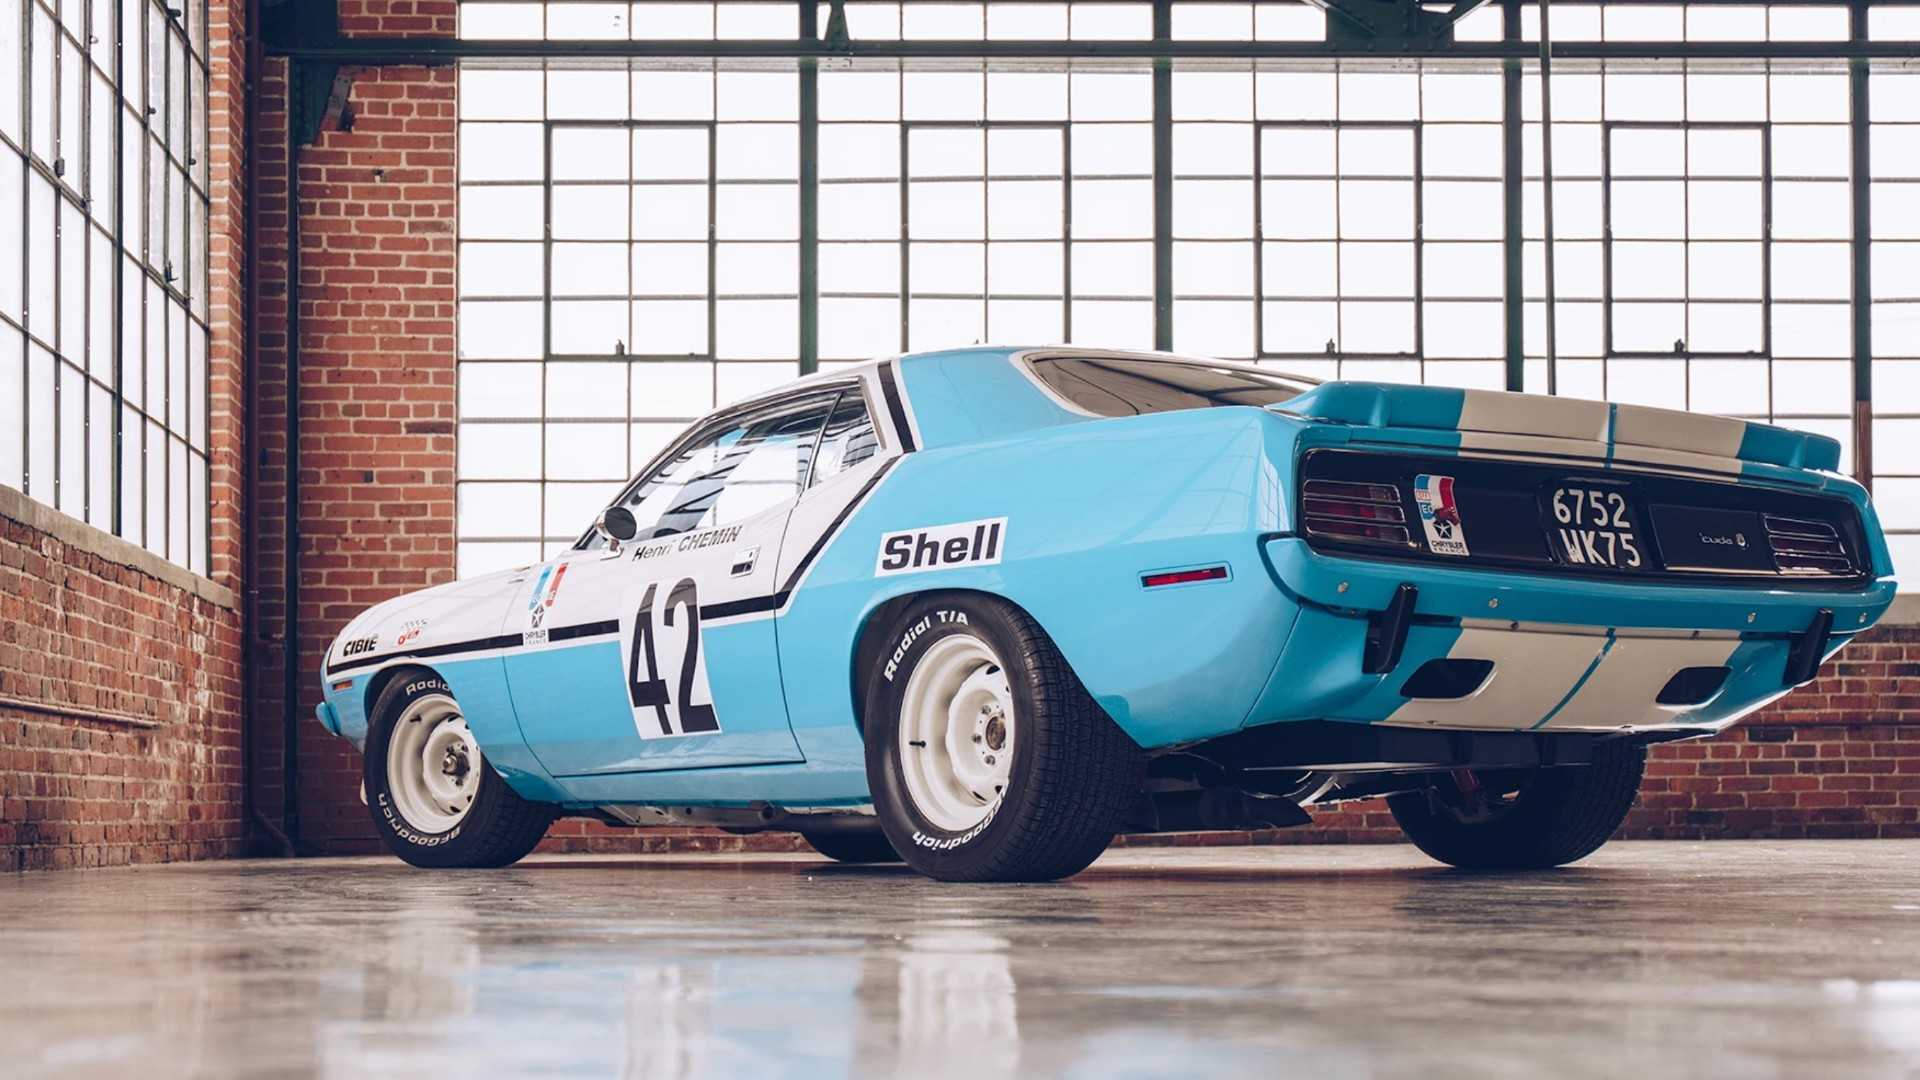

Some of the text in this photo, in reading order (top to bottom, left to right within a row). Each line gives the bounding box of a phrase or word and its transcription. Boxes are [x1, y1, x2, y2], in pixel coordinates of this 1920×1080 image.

[1553, 488, 1631, 528] 6752
[678, 525, 744, 553] CHEMIN
[882, 523, 1001, 571] Shell
[1560, 528, 1641, 567] WK75
[629, 577, 720, 735] 42
[884, 610, 969, 682] Radial T/A
